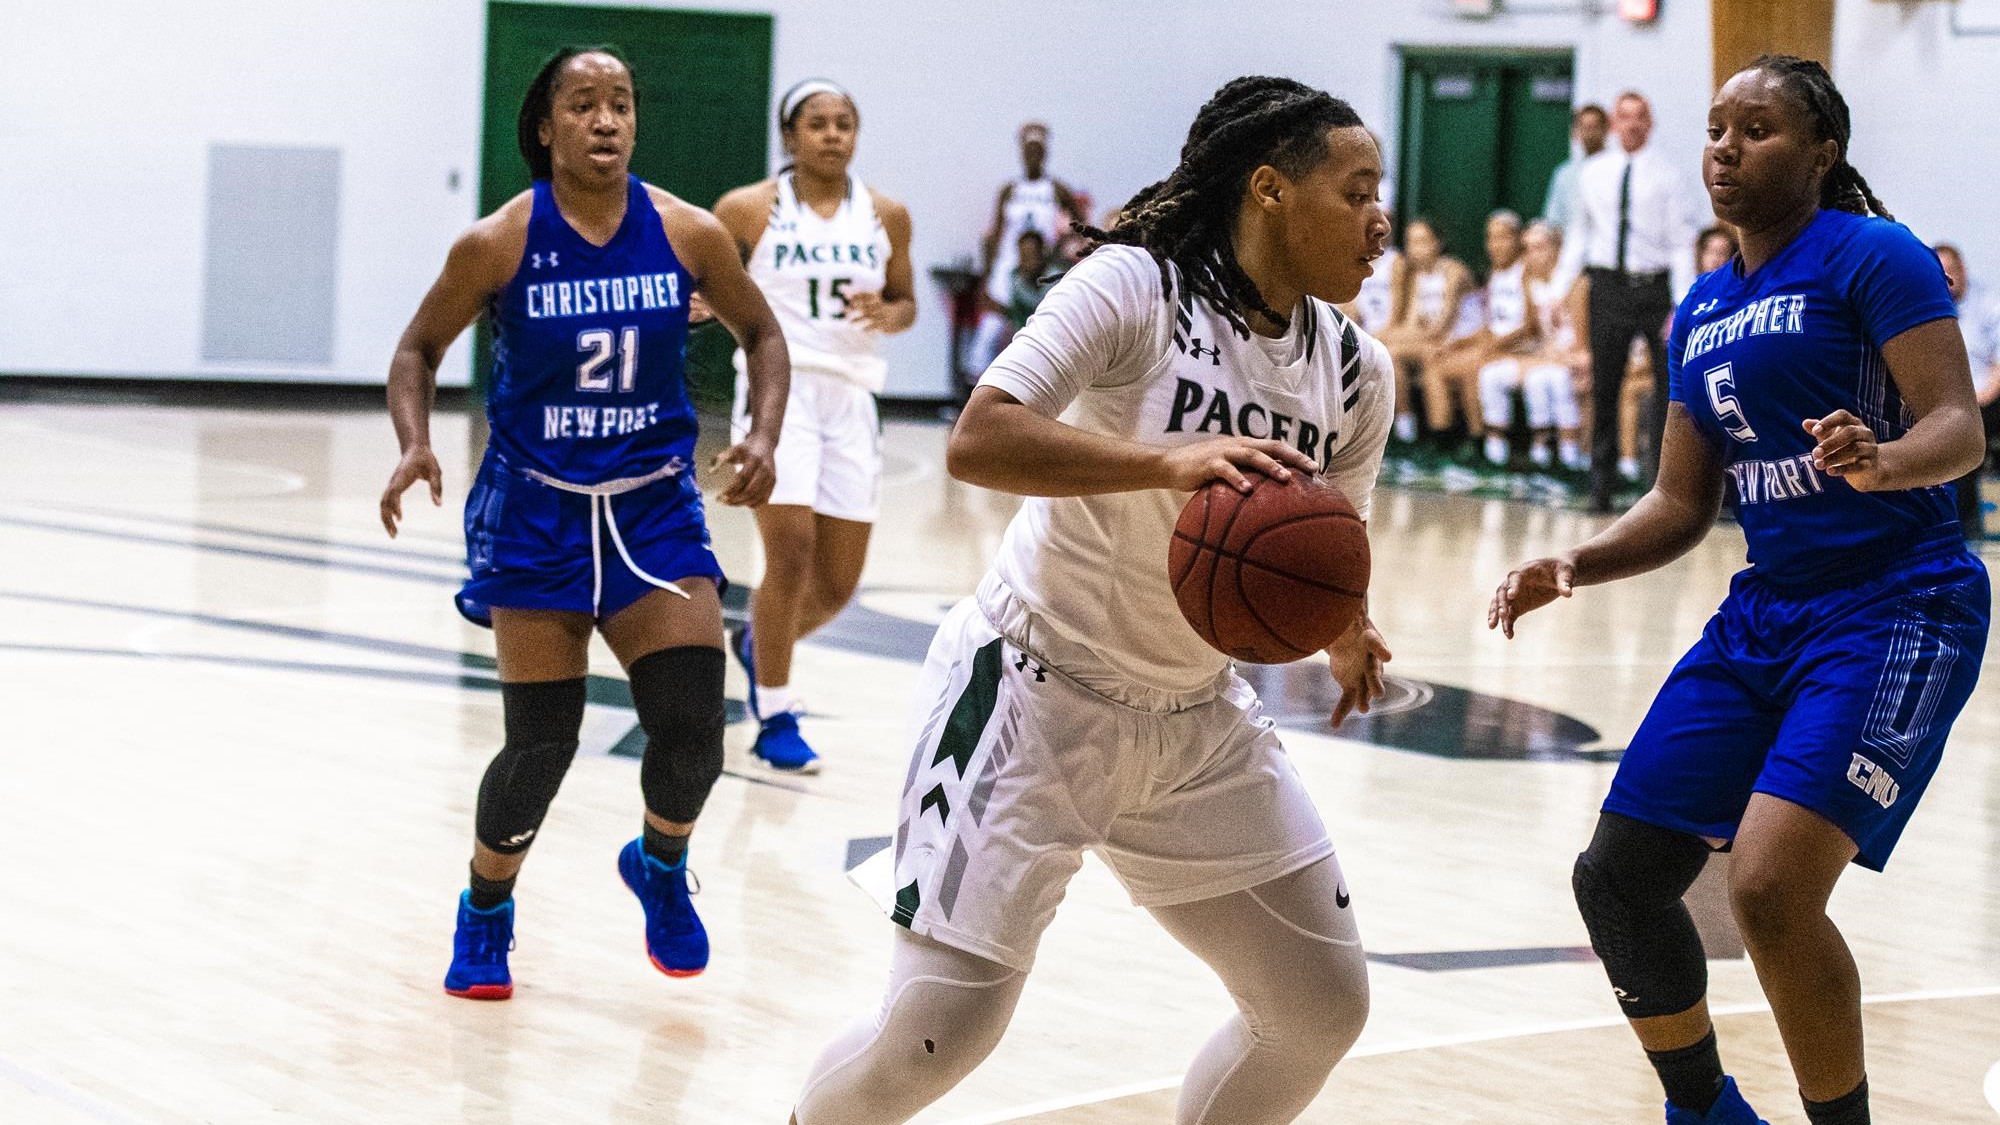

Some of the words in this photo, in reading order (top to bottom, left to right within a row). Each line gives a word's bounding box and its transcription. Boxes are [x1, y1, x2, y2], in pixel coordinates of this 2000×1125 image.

[774, 241, 878, 270] PACERS
[527, 272, 681, 319] CHRISTOPHER
[807, 277, 853, 320] 15
[575, 326, 640, 393] 21
[1163, 376, 1338, 476] PACERS
[1703, 361, 1759, 444] 5
[1846, 752, 1901, 810] CNU
